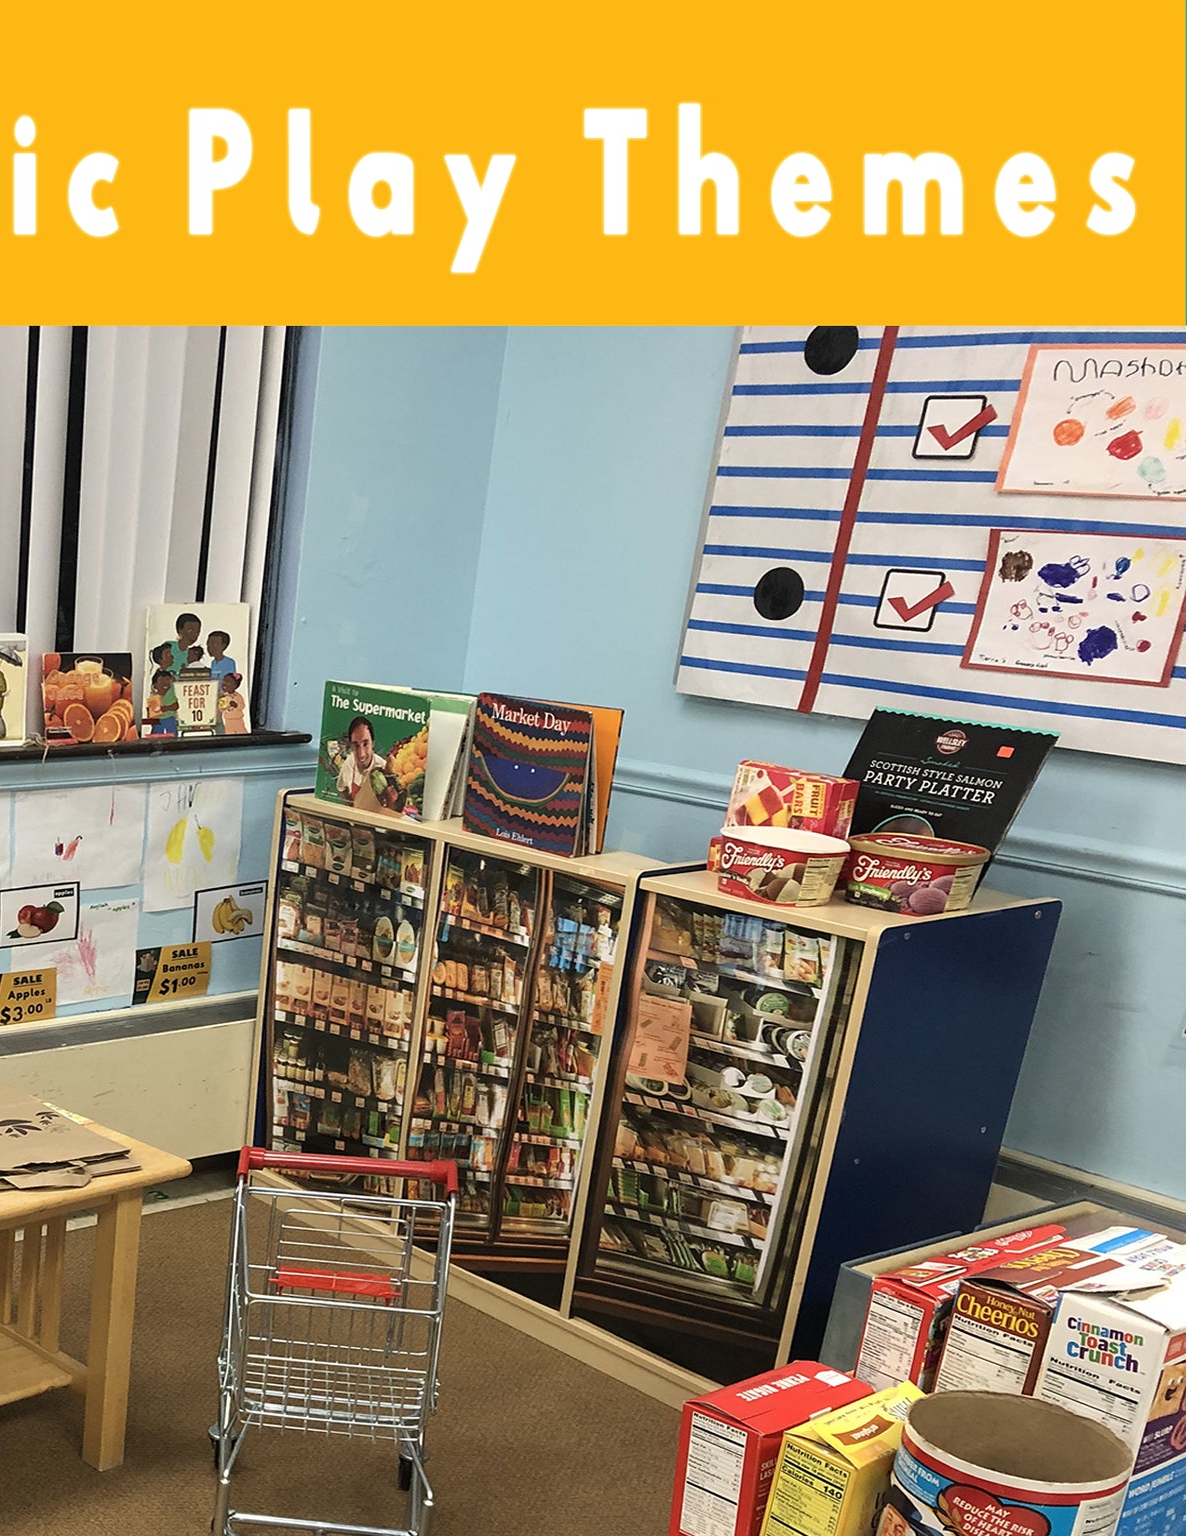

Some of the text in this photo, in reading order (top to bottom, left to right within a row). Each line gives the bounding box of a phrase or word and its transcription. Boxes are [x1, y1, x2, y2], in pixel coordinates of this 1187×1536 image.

[183, 684, 211, 697] FEAST
[188, 697, 206, 710] FOR
[191, 709, 203, 722] 10
[331, 694, 427, 725] The Supermarket
[492, 703, 571, 736] Market Day
[863, 770, 918, 791] PARTY
[918, 780, 996, 805] PLATTER
[869, 759, 1004, 790] SCOTTISH STYLE SALMON
[793, 783, 805, 815] BARS
[809, 784, 821, 817] FRUIT
[496, 828, 534, 845] Lois Ehlert
[721, 843, 785, 873] Friendly's
[852, 855, 932, 886] Friendly's
[55, 889, 74, 897] apples
[163, 961, 205, 973] Bananas
[172, 948, 198, 959] SALE
[13, 974, 42, 984] SALE
[159, 976, 196, 996] $1.00
[8, 988, 46, 1001] Apples
[0, 1002, 43, 1026] $3.00
[956, 1292, 1039, 1338] Cheerios
[986, 1295, 1036, 1321] Honey Nut
[954, 1314, 1034, 1348] Nutrition Facts
[1067, 1316, 1144, 1347] Cinnamon
[1078, 1330, 1127, 1357] Toast
[1066, 1341, 1139, 1374] Crunch
[736, 1374, 811, 1401] PENNE RIGATE
[1050, 1357, 1142, 1395] Nutrition Facts
[693, 1412, 746, 1437] Nutrition Facts
[787, 1443, 822, 1466] Nutrition
[824, 1463, 848, 1479] Facts
[781, 1465, 814, 1486] Calories
[822, 1485, 843, 1500] 140
[953, 1496, 988, 1518] REDUCE
[989, 1512, 1010, 1527] THE
[963, 1512, 978, 1525] OF
[985, 1503, 1011, 1518] MAY
